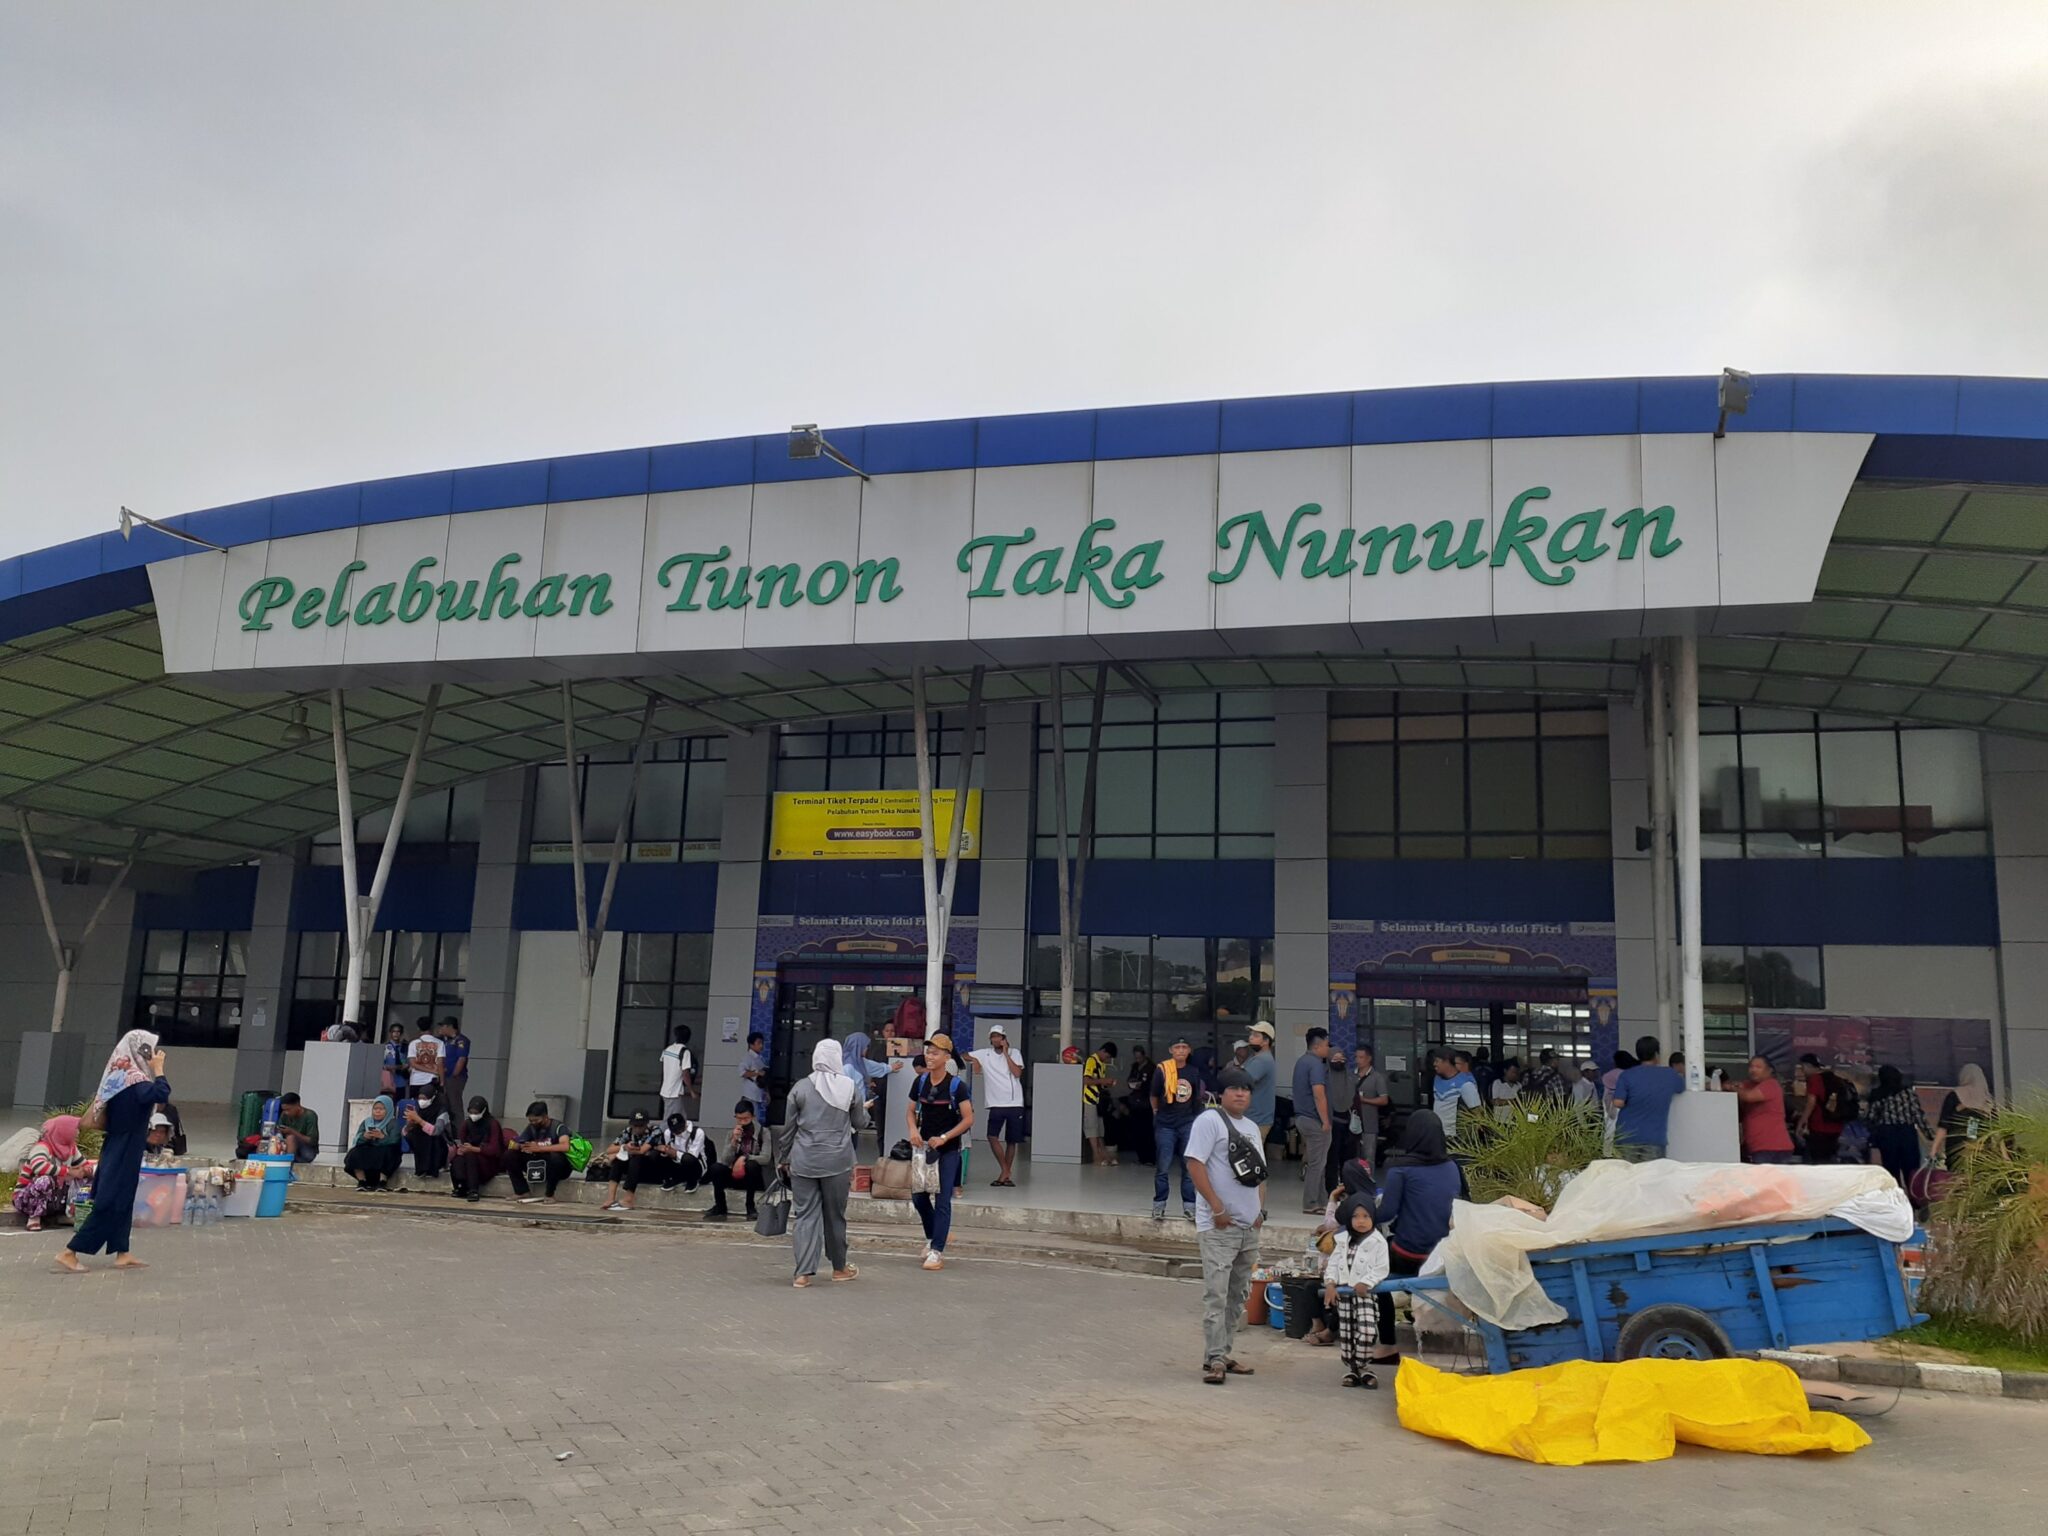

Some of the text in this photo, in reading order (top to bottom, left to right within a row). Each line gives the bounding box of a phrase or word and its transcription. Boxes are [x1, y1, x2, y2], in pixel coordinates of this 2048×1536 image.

[239, 486, 1682, 632] Pelabuhan Tunon Taka Nunukan
[793, 797, 825, 805] Terminal
[828, 797, 847, 805] Tiket
[849, 796, 878, 806] Terpadu
[833, 829, 915, 839] www.easybook.com
[799, 917, 838, 926] Selamat
[840, 917, 863, 926] Hari
[865, 917, 890, 928] Raya
[892, 917, 912, 926] Idul
[1380, 922, 1431, 933] Selamat
[1434, 922, 1463, 934] Hari
[1466, 923, 1498, 936] Raya
[1501, 923, 1529, 935] Idul
[1531, 923, 1562, 935] Fitri
